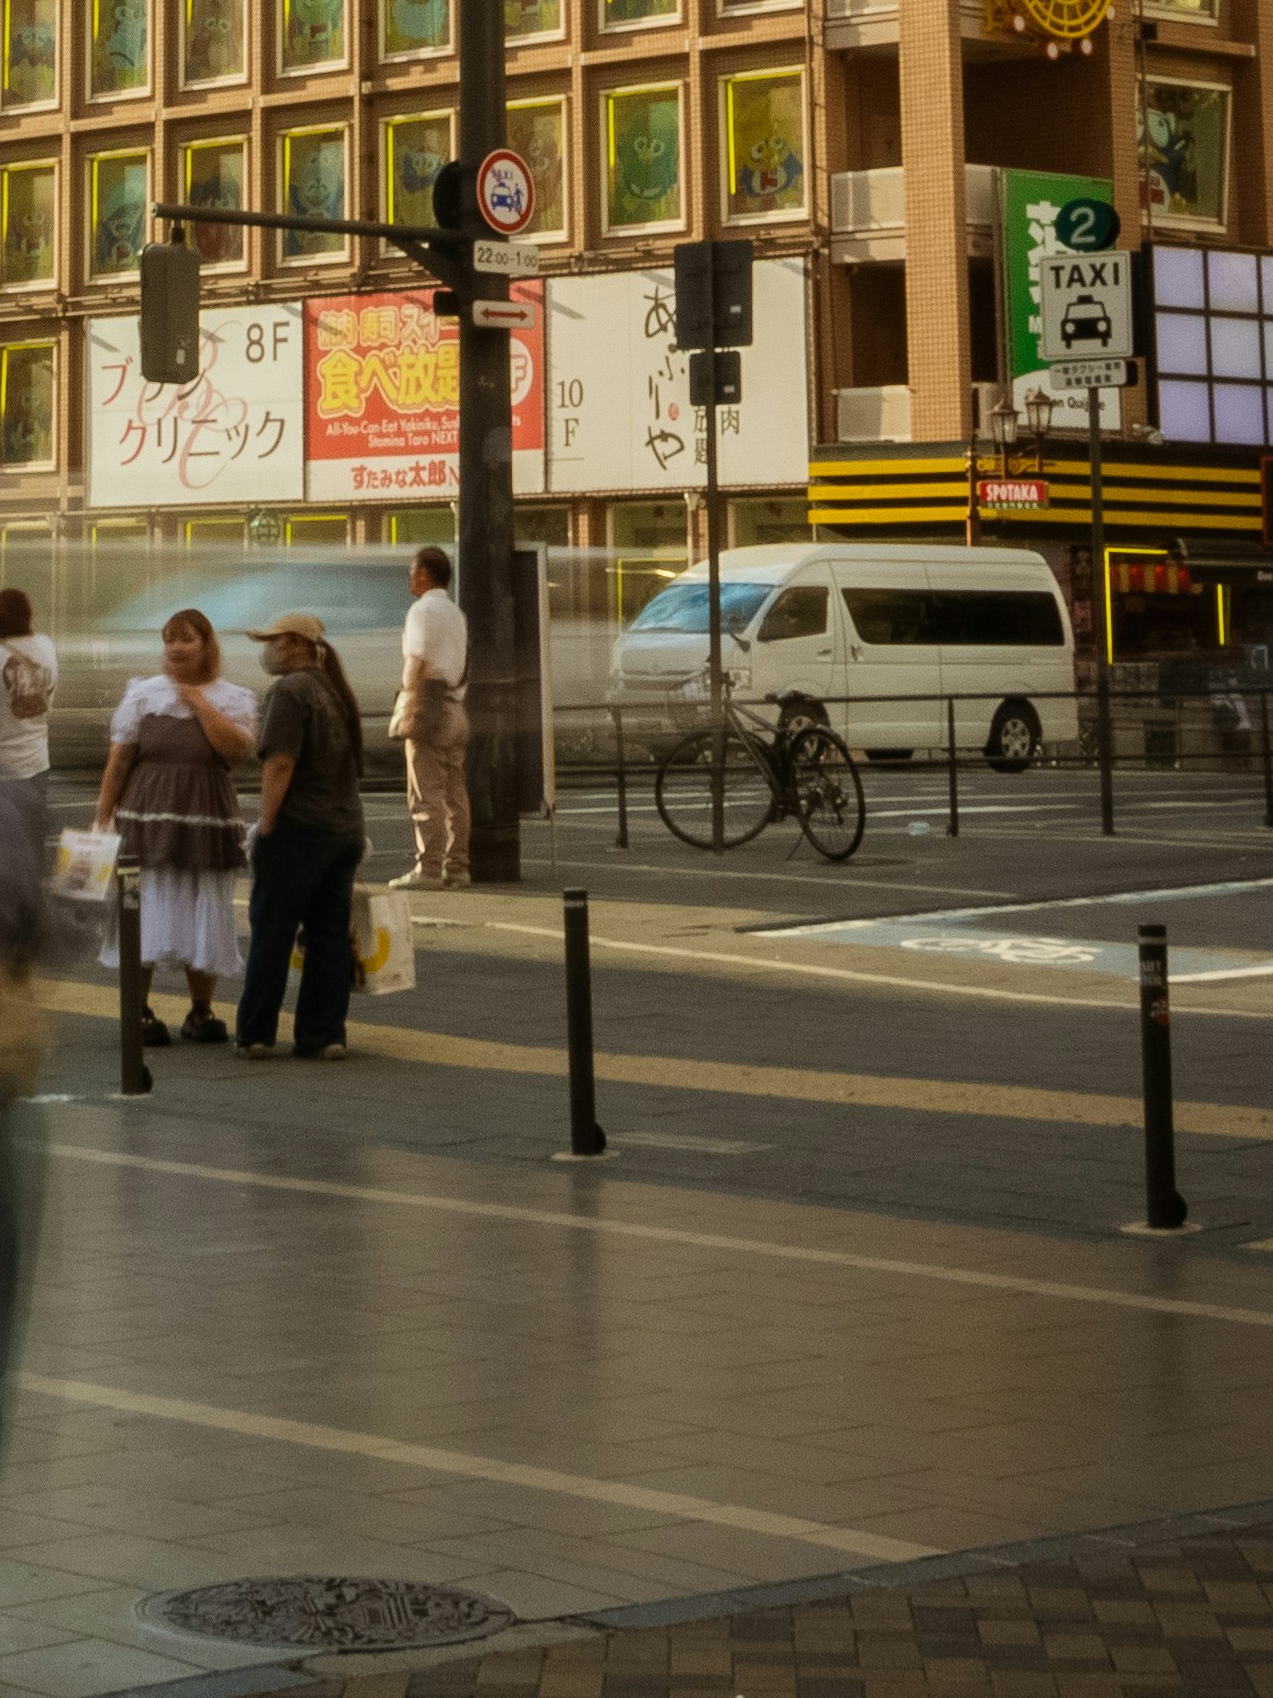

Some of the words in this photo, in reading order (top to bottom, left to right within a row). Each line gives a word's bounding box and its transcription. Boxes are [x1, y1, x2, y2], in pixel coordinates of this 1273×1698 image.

[1069, 206, 1097, 245] 2
[1049, 261, 1121, 290] TAXI
[245, 321, 291, 364] 8F
[102, 355, 207, 406] ブン
[557, 378, 584, 408] 10
[119, 410, 286, 466] クリニック
[564, 418, 580, 447] F
[986, 483, 1039, 502] SPOTAKA
